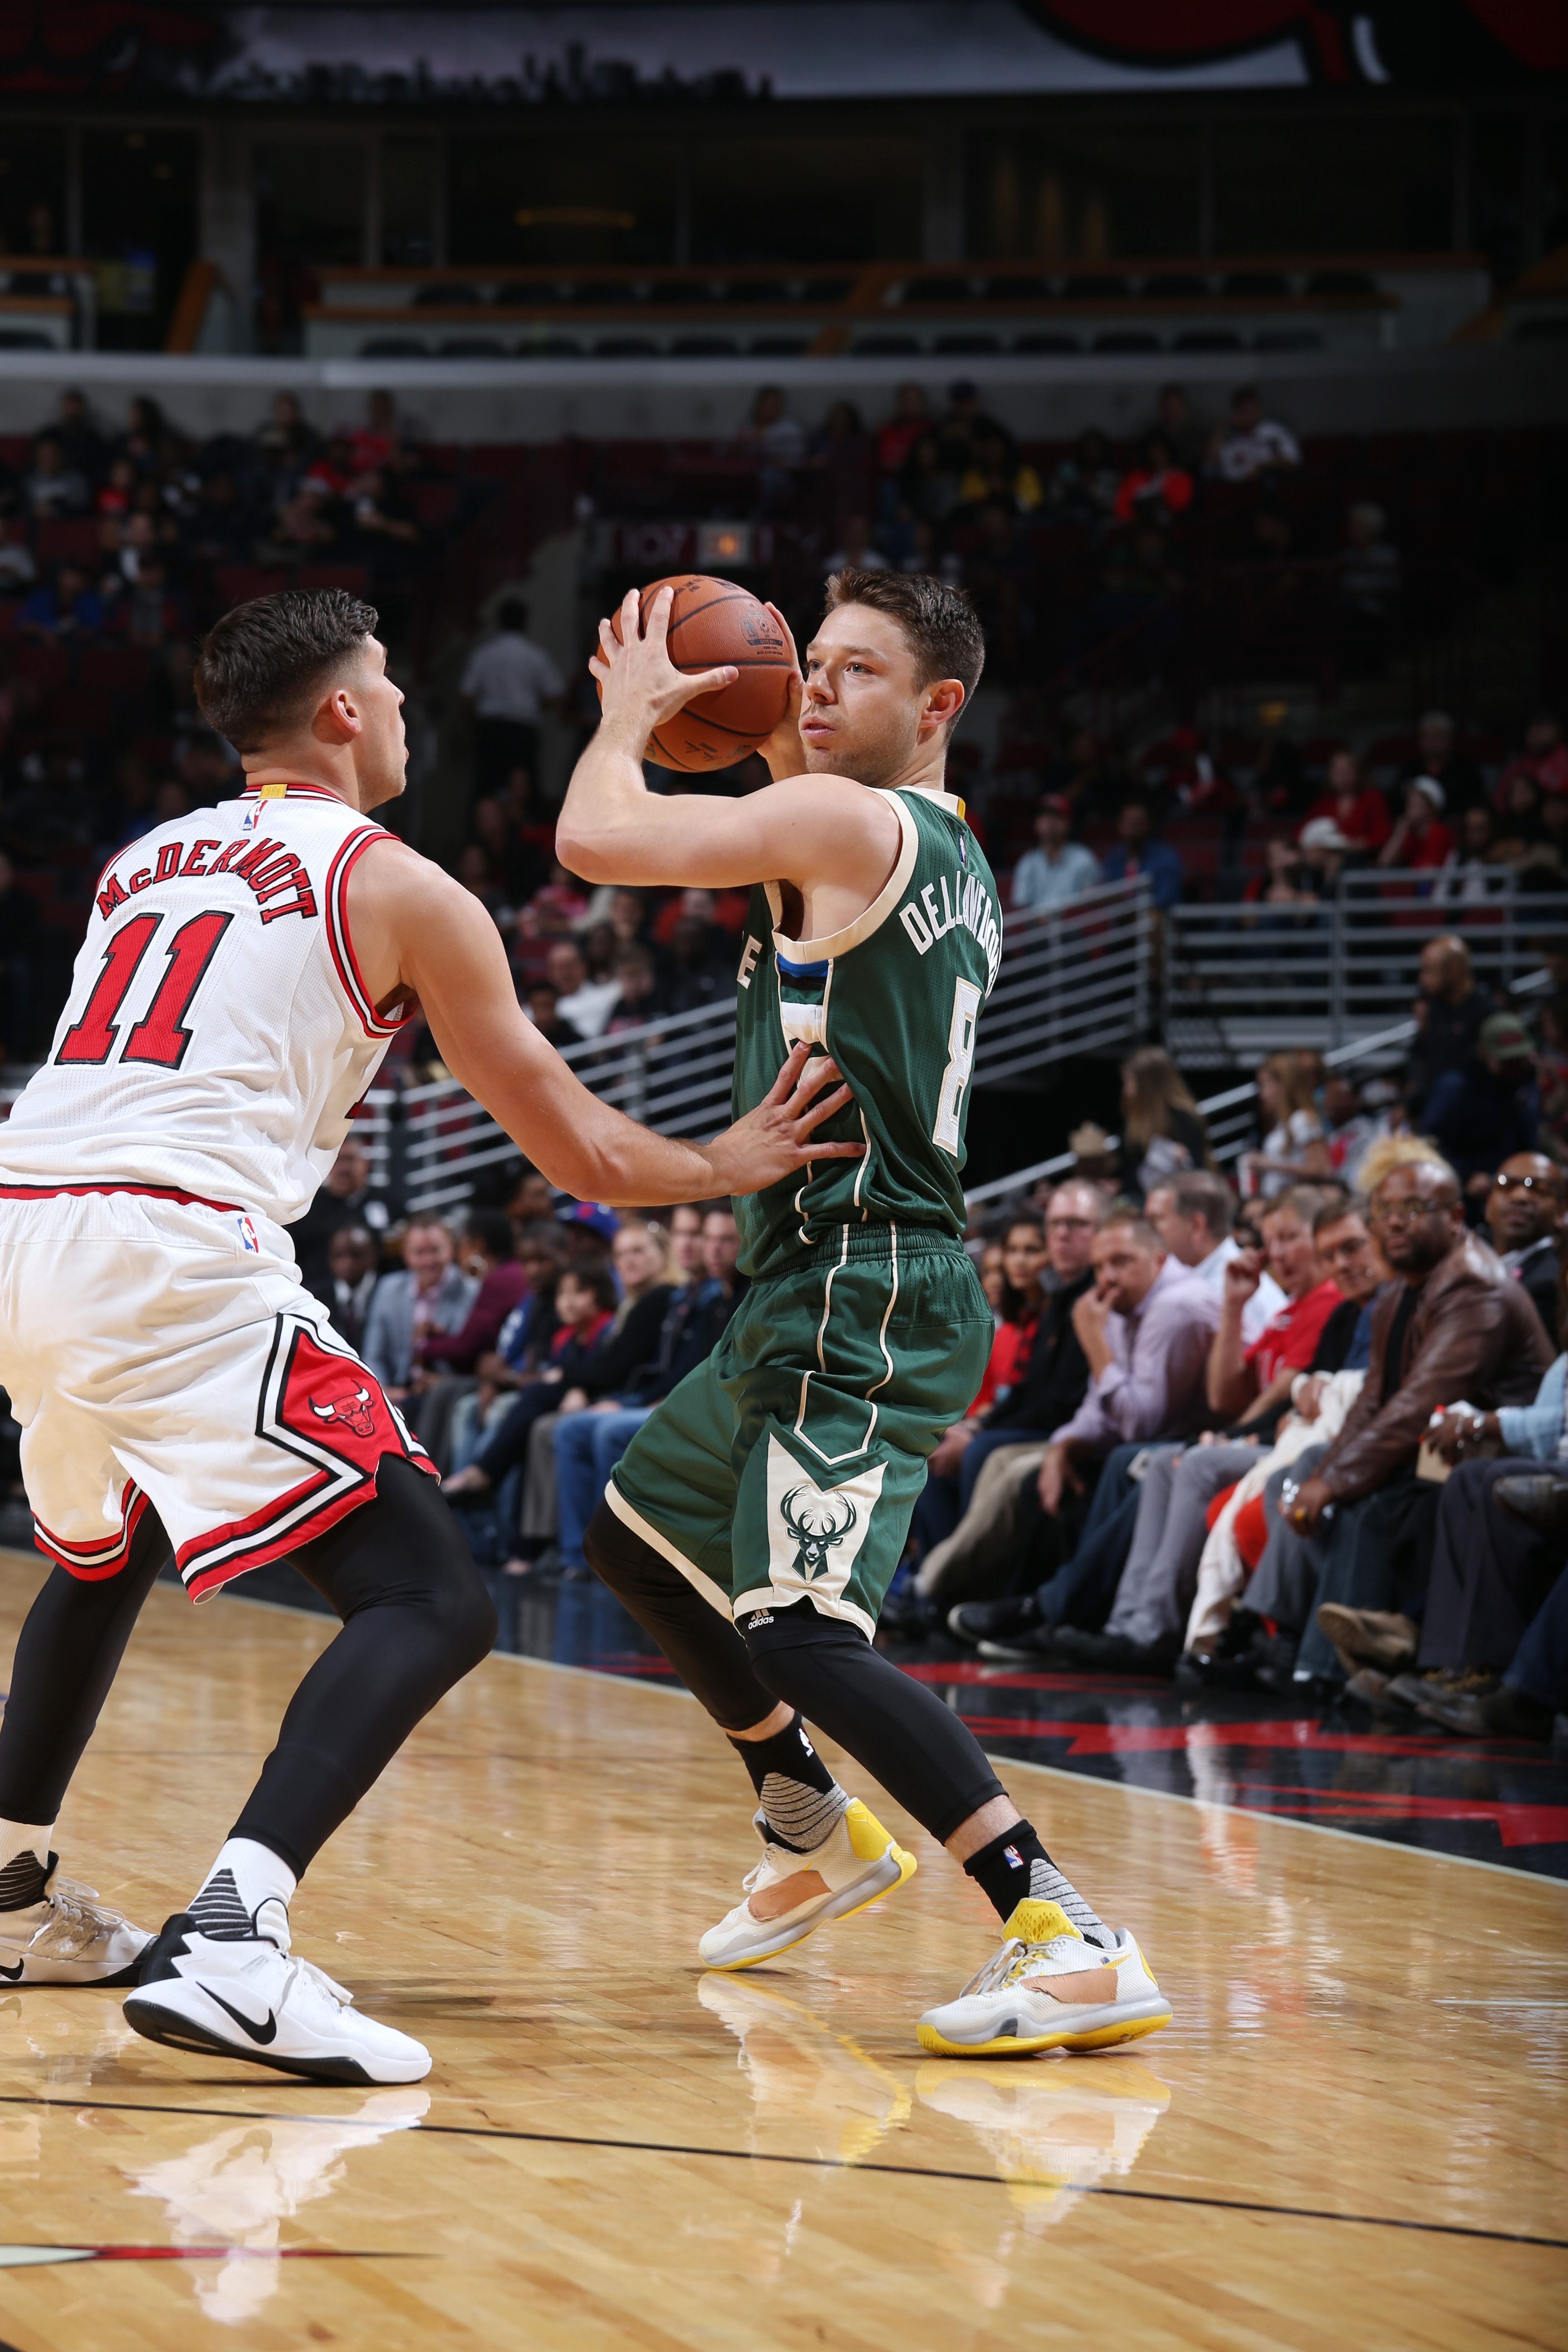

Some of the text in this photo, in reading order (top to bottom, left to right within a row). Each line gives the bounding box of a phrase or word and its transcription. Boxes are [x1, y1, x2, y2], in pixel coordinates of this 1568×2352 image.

[96, 837, 318, 924] McDERMOTT
[54, 910, 235, 1069] 11
[932, 976, 982, 1158] 8
[748, 1616, 774, 1630] adidas
[1009, 1859, 1022, 1869] NBA
